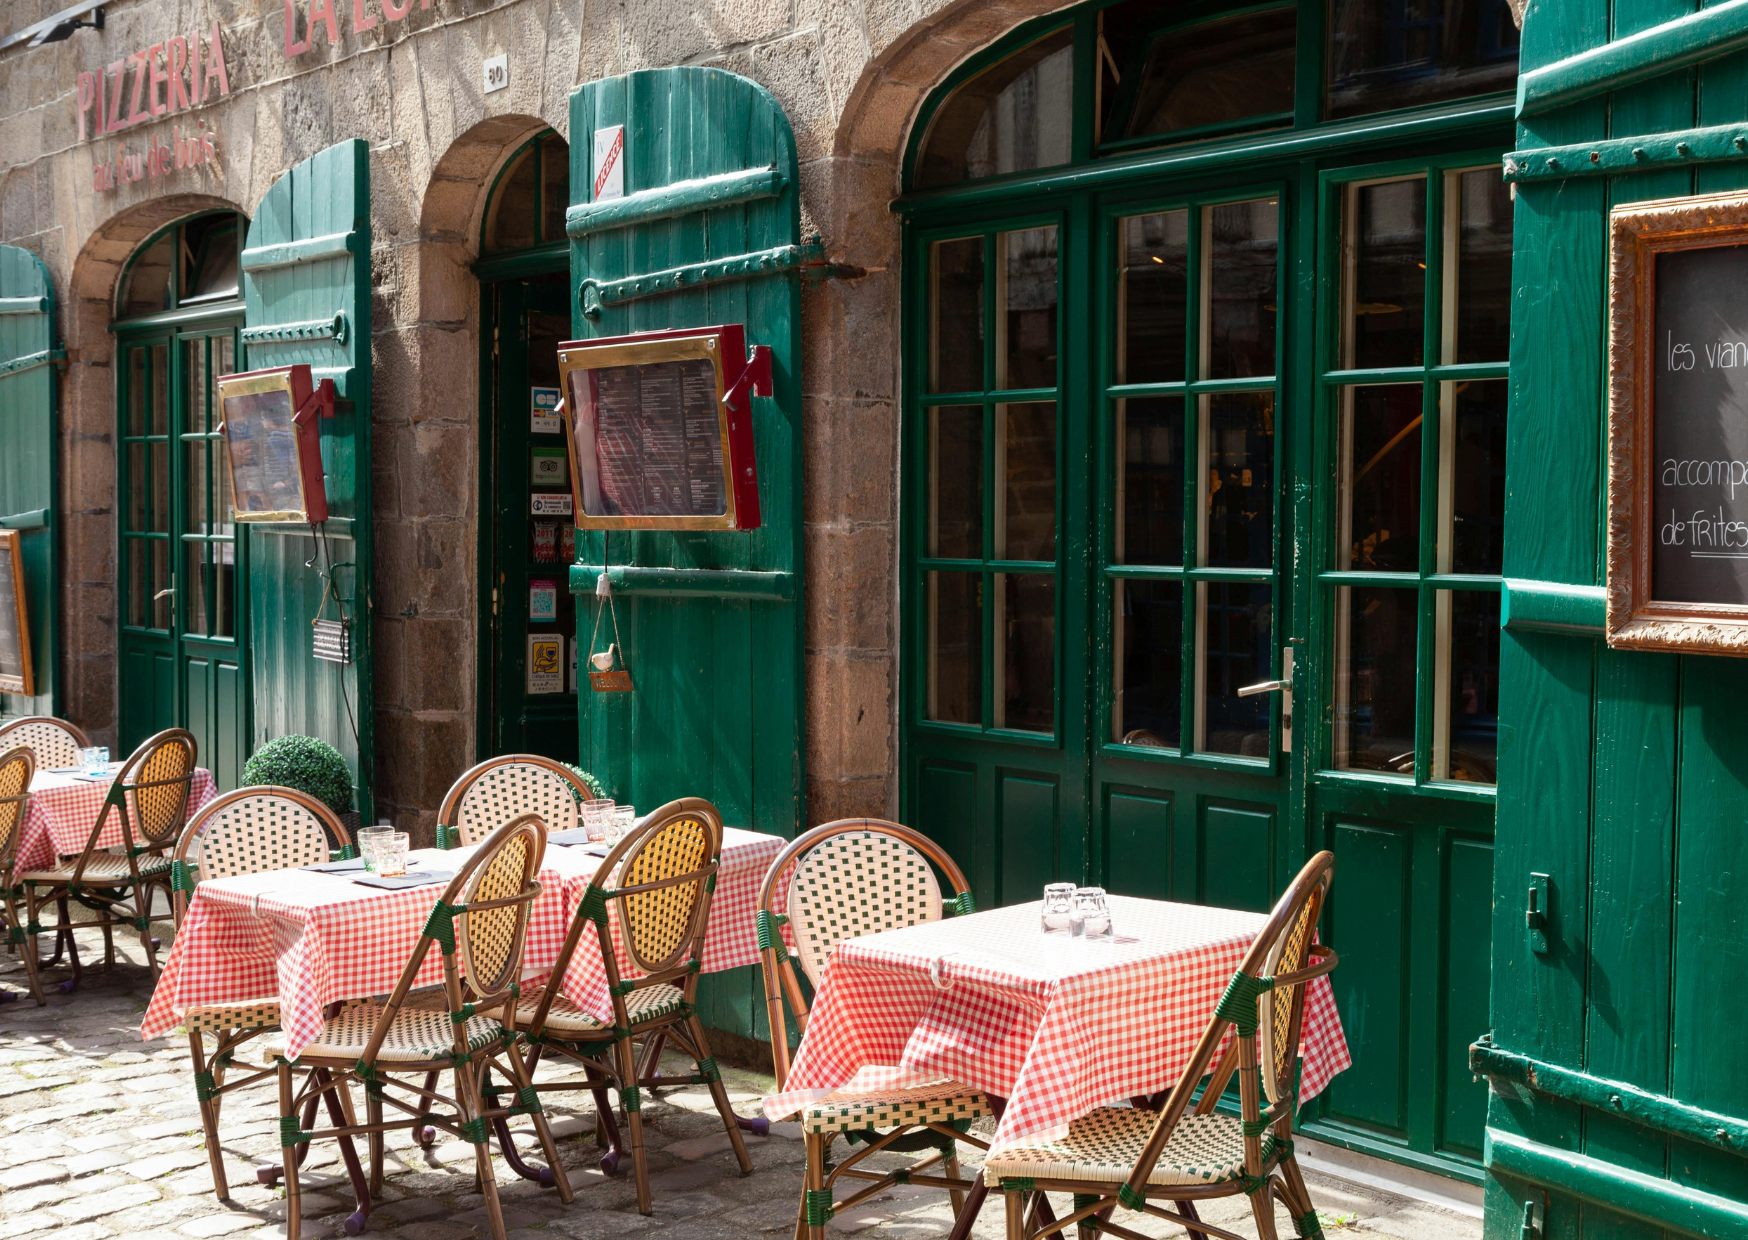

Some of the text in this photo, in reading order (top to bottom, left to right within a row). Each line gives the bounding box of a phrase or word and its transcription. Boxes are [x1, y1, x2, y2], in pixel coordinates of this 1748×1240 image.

[77, 21, 230, 142] PIZZERIA
[93, 119, 215, 193] au feu de bois
[597, 136, 621, 192] LICENCE
[1667, 329, 1748, 371] les vian
[536, 529, 553, 537] 2011
[1661, 508, 1685, 546] de
[593, 676, 629, 688] WELCOME
